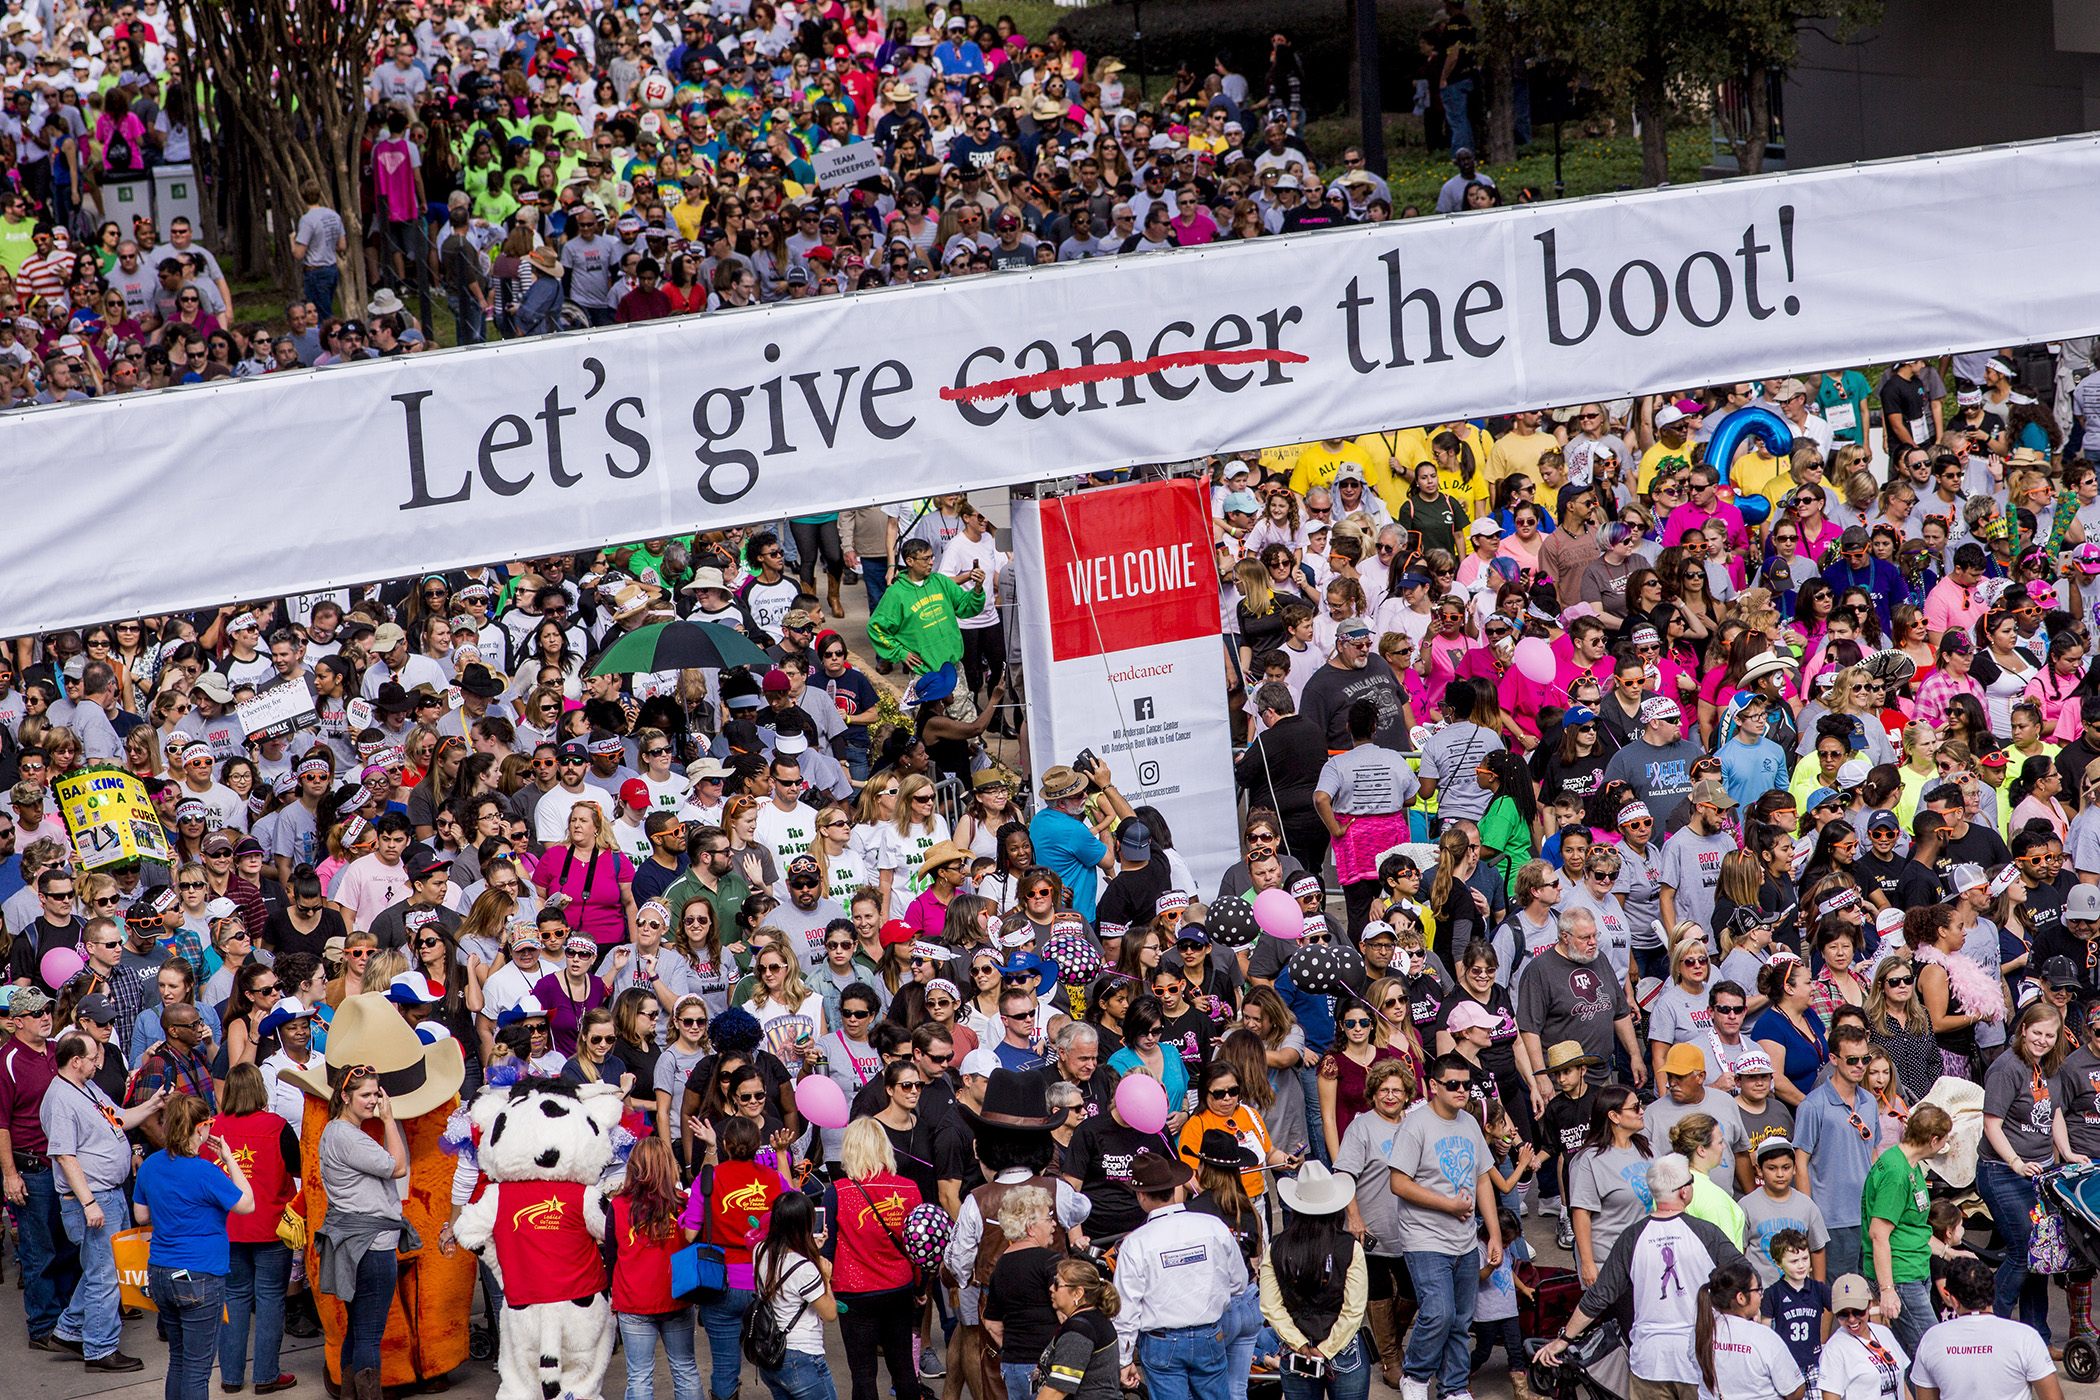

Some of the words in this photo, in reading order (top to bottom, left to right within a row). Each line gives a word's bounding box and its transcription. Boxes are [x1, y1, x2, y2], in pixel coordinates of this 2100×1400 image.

[832, 153, 856, 168] TEAM
[820, 158, 876, 182] GATEKEEPERS
[391, 357, 651, 511] Let's
[693, 343, 916, 504] give
[953, 305, 1303, 427] cancer
[1338, 249, 1504, 373] the
[1534, 205, 1800, 346] boot!
[1318, 465, 1337, 477] ALL
[1451, 479, 1472, 494] DAY
[1066, 542, 1197, 606] WELCOME
[2029, 641, 2043, 650] BOOT
[1107, 662, 1174, 684] #endcancer
[1343, 674, 1390, 698] BADLANDS
[241, 702, 271, 720] Cheering
[273, 697, 282, 708] for
[352, 701, 370, 716] BOOT
[321, 711, 344, 722] BOOT
[351, 711, 371, 723] WALK
[320, 720, 344, 731] WALK
[1112, 730, 1123, 740] MD
[1122, 725, 1146, 739] Anderson
[1146, 722, 1162, 735] Cancer
[1163, 719, 1179, 732] Center
[208, 728, 230, 741] BOOT
[249, 728, 267, 743] BOOT
[266, 721, 289, 735] WALK
[1411, 729, 1429, 740] BOOT
[209, 738, 232, 750] WALK
[1101, 744, 1110, 755] MD
[1111, 740, 1134, 753] Anderson
[1134, 738, 1147, 750] Boot
[1147, 735, 1159, 747] Walk
[1165, 733, 1175, 744] End
[1176, 730, 1192, 742] Cancer
[1581, 774, 1593, 784] Out
[1648, 788, 1667, 797] EAGLES
[87, 793, 110, 809] ON
[116, 792, 127, 804] A
[659, 794, 676, 806] The
[131, 808, 158, 824] CURE
[786, 828, 804, 840] The
[636, 840, 651, 853] The
[916, 837, 934, 848] The
[777, 844, 794, 857] Bob
[628, 855, 644, 868] Bob
[905, 853, 923, 866] Bob
[1698, 852, 1720, 864] BOOT
[1699, 862, 1722, 872] WALK
[835, 869, 854, 881] The
[828, 885, 845, 897] Bob
[2033, 907, 2057, 922] PEEP'S
[1604, 923, 1625, 933] WALK
[1570, 999, 1613, 1022] Aggies
[1690, 1010, 1711, 1022] BOO
[1560, 1128, 1578, 1138] Stamp
[1560, 1135, 1575, 1144] Stage
[1566, 1140, 1582, 1150] Breast
[1103, 1154, 1126, 1164] Stamp
[1101, 1161, 1121, 1170] Stage
[1121, 1161, 1128, 1170] IV
[1106, 1168, 1127, 1178] Breast
[1783, 1306, 1818, 1321] MEMPHIS
[1789, 1320, 1809, 1342] 33
[1946, 1344, 1993, 1355] VOLUNTEER
